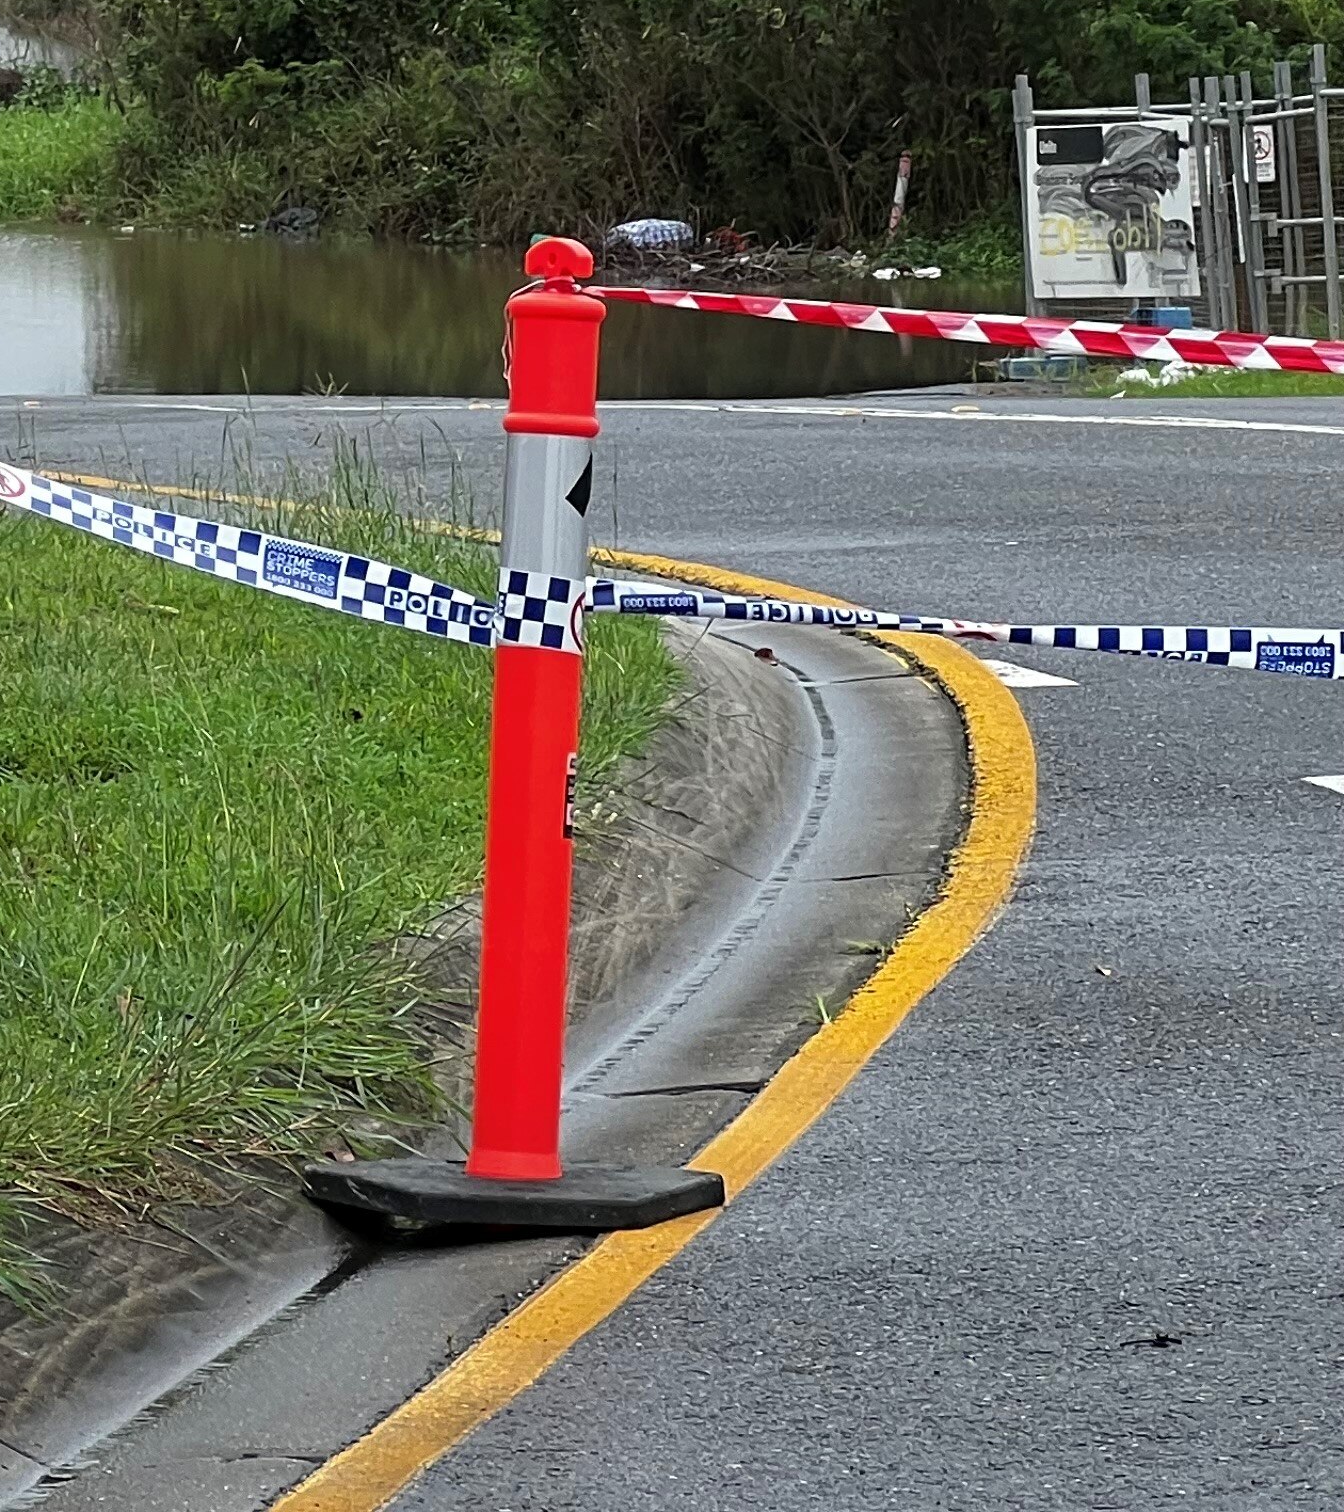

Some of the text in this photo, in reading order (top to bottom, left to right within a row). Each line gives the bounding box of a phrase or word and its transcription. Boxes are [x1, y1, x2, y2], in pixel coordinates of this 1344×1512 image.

[96, 509, 212, 556] POLICE
[266, 560, 336, 587] STOPPERS
[267, 550, 315, 572] CRIME
